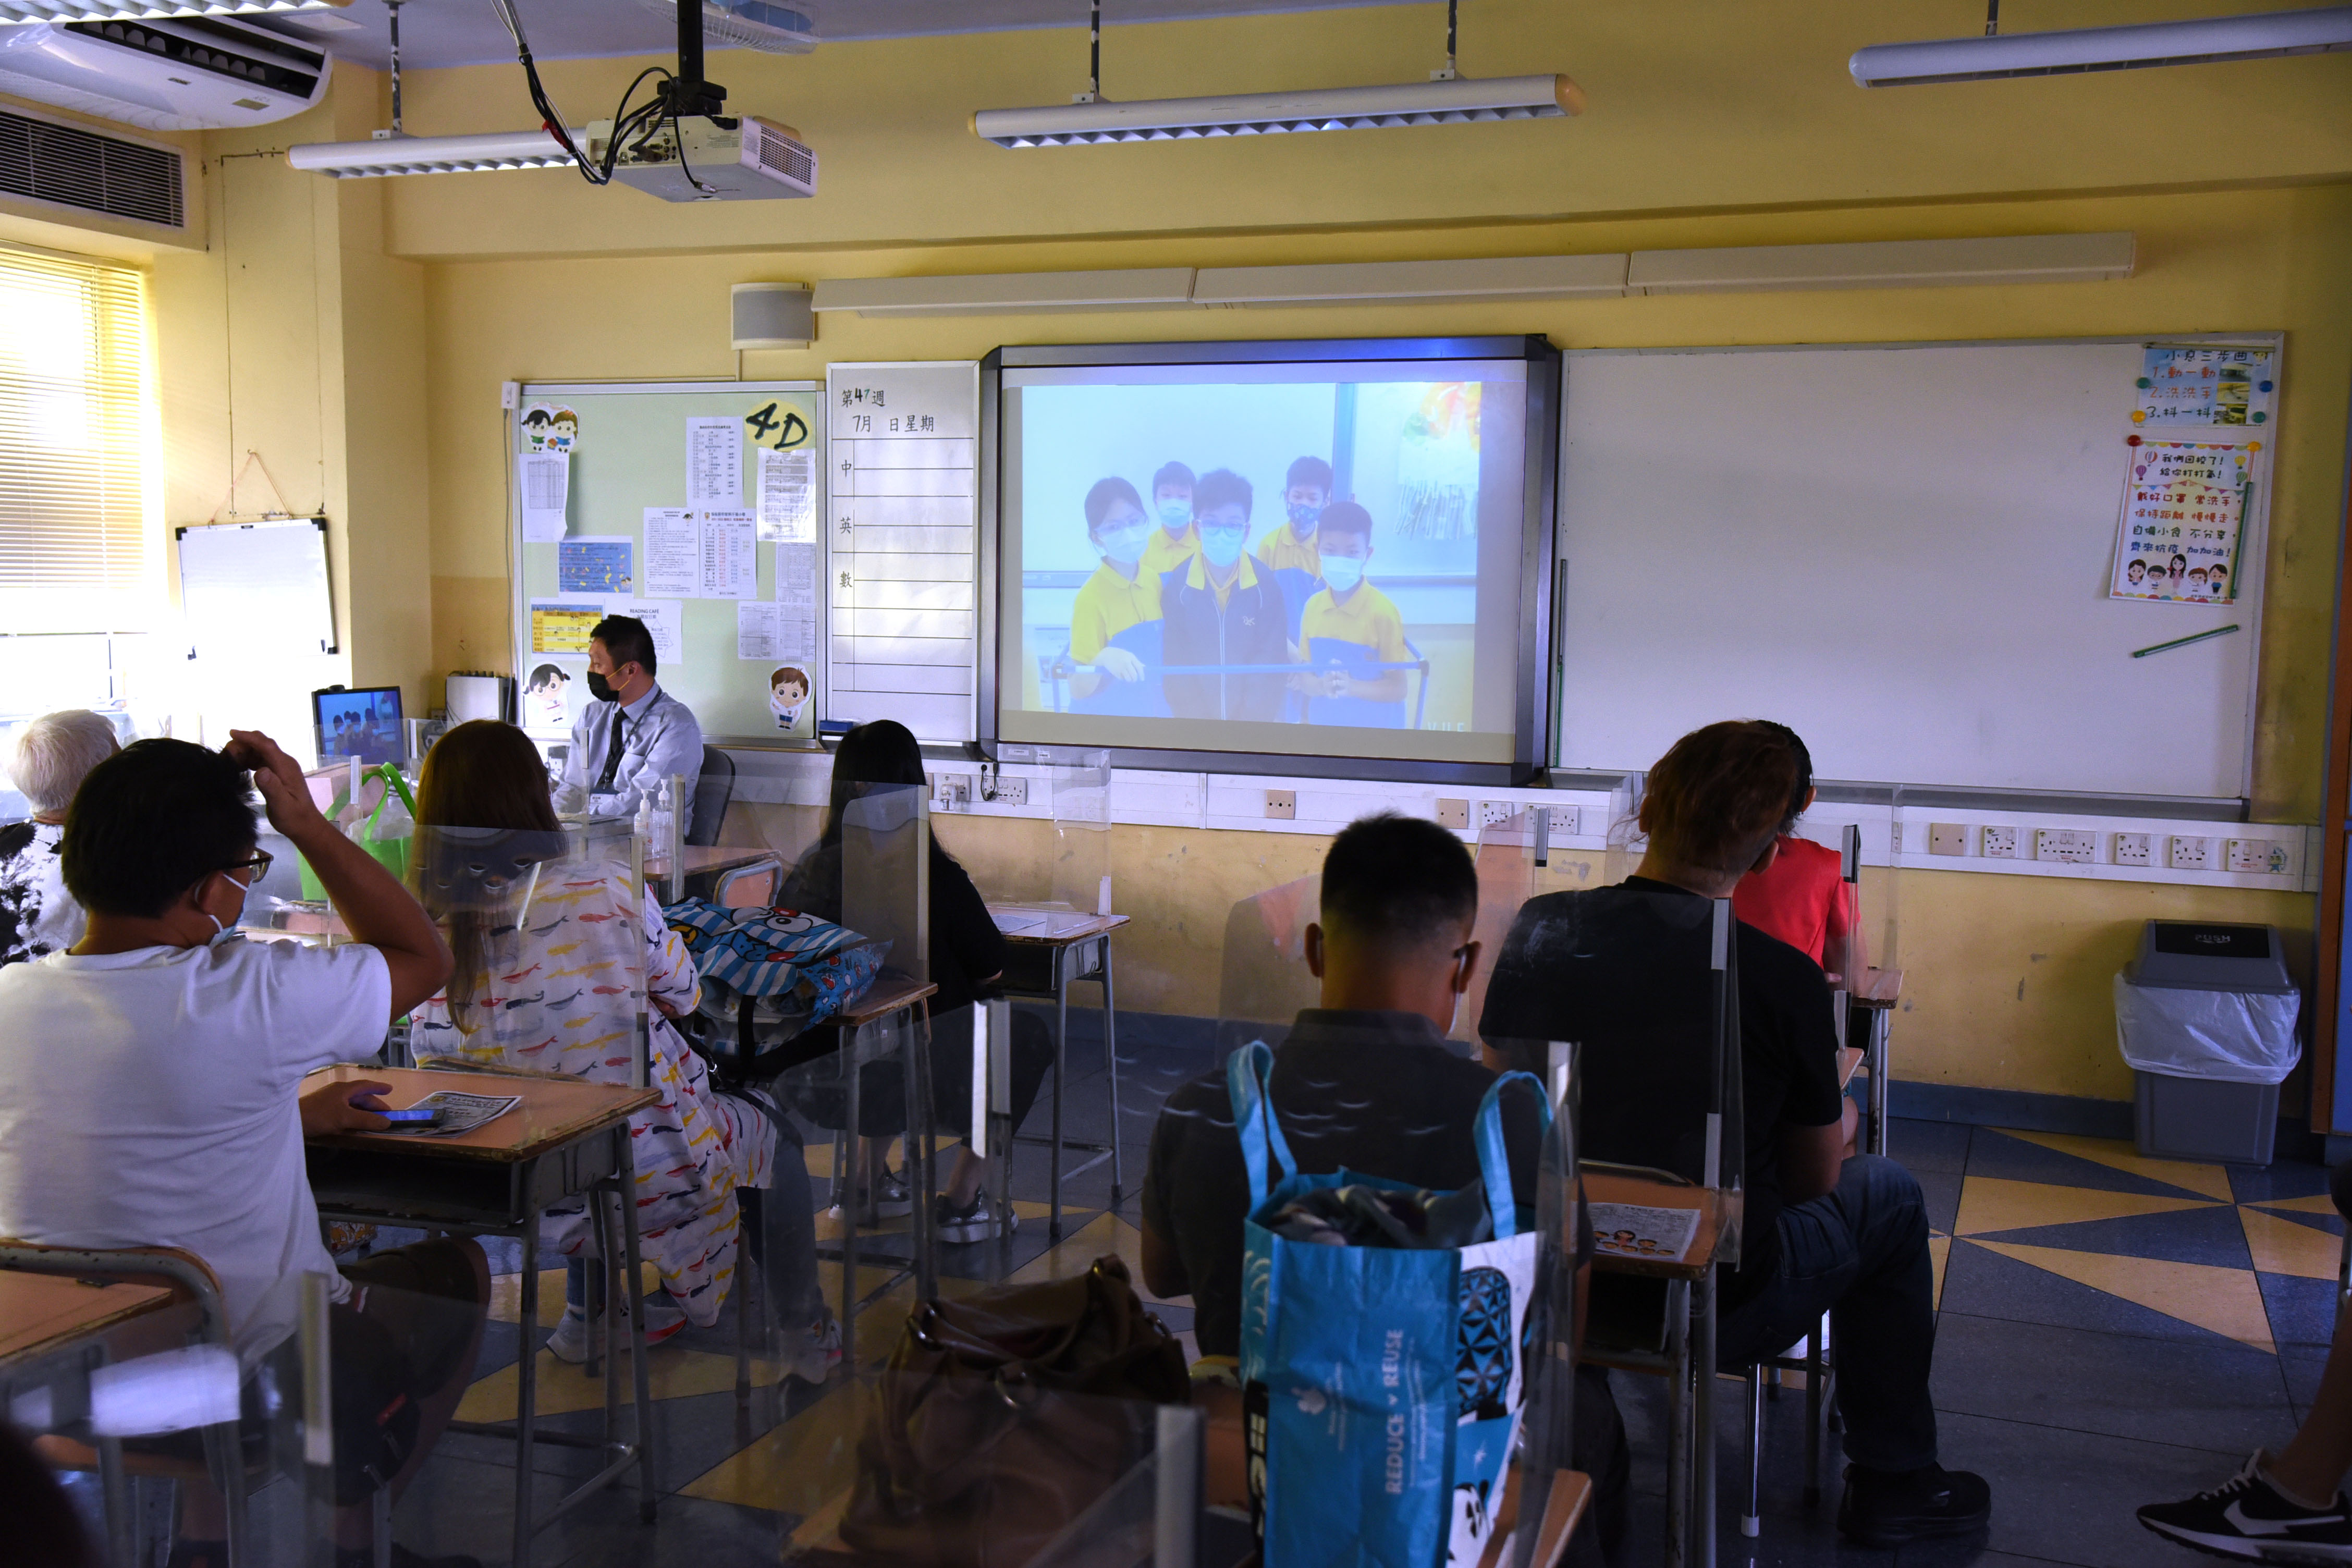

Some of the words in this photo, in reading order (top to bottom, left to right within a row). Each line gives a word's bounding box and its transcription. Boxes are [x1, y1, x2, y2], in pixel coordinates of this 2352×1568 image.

[2153, 366, 2215, 378] 1.動一動
[841, 387, 885, 408] 第47週
[2149, 386, 2212, 399] 2.洗洗手
[745, 402, 808, 450] 4D
[852, 415, 871, 433] 7月
[841, 459, 852, 477] 中
[840, 516, 852, 534] 英
[840, 571, 853, 589] 數
[1381, 1329, 1404, 1387] REUSE
[1385, 1414, 1405, 1495] REDUCE
